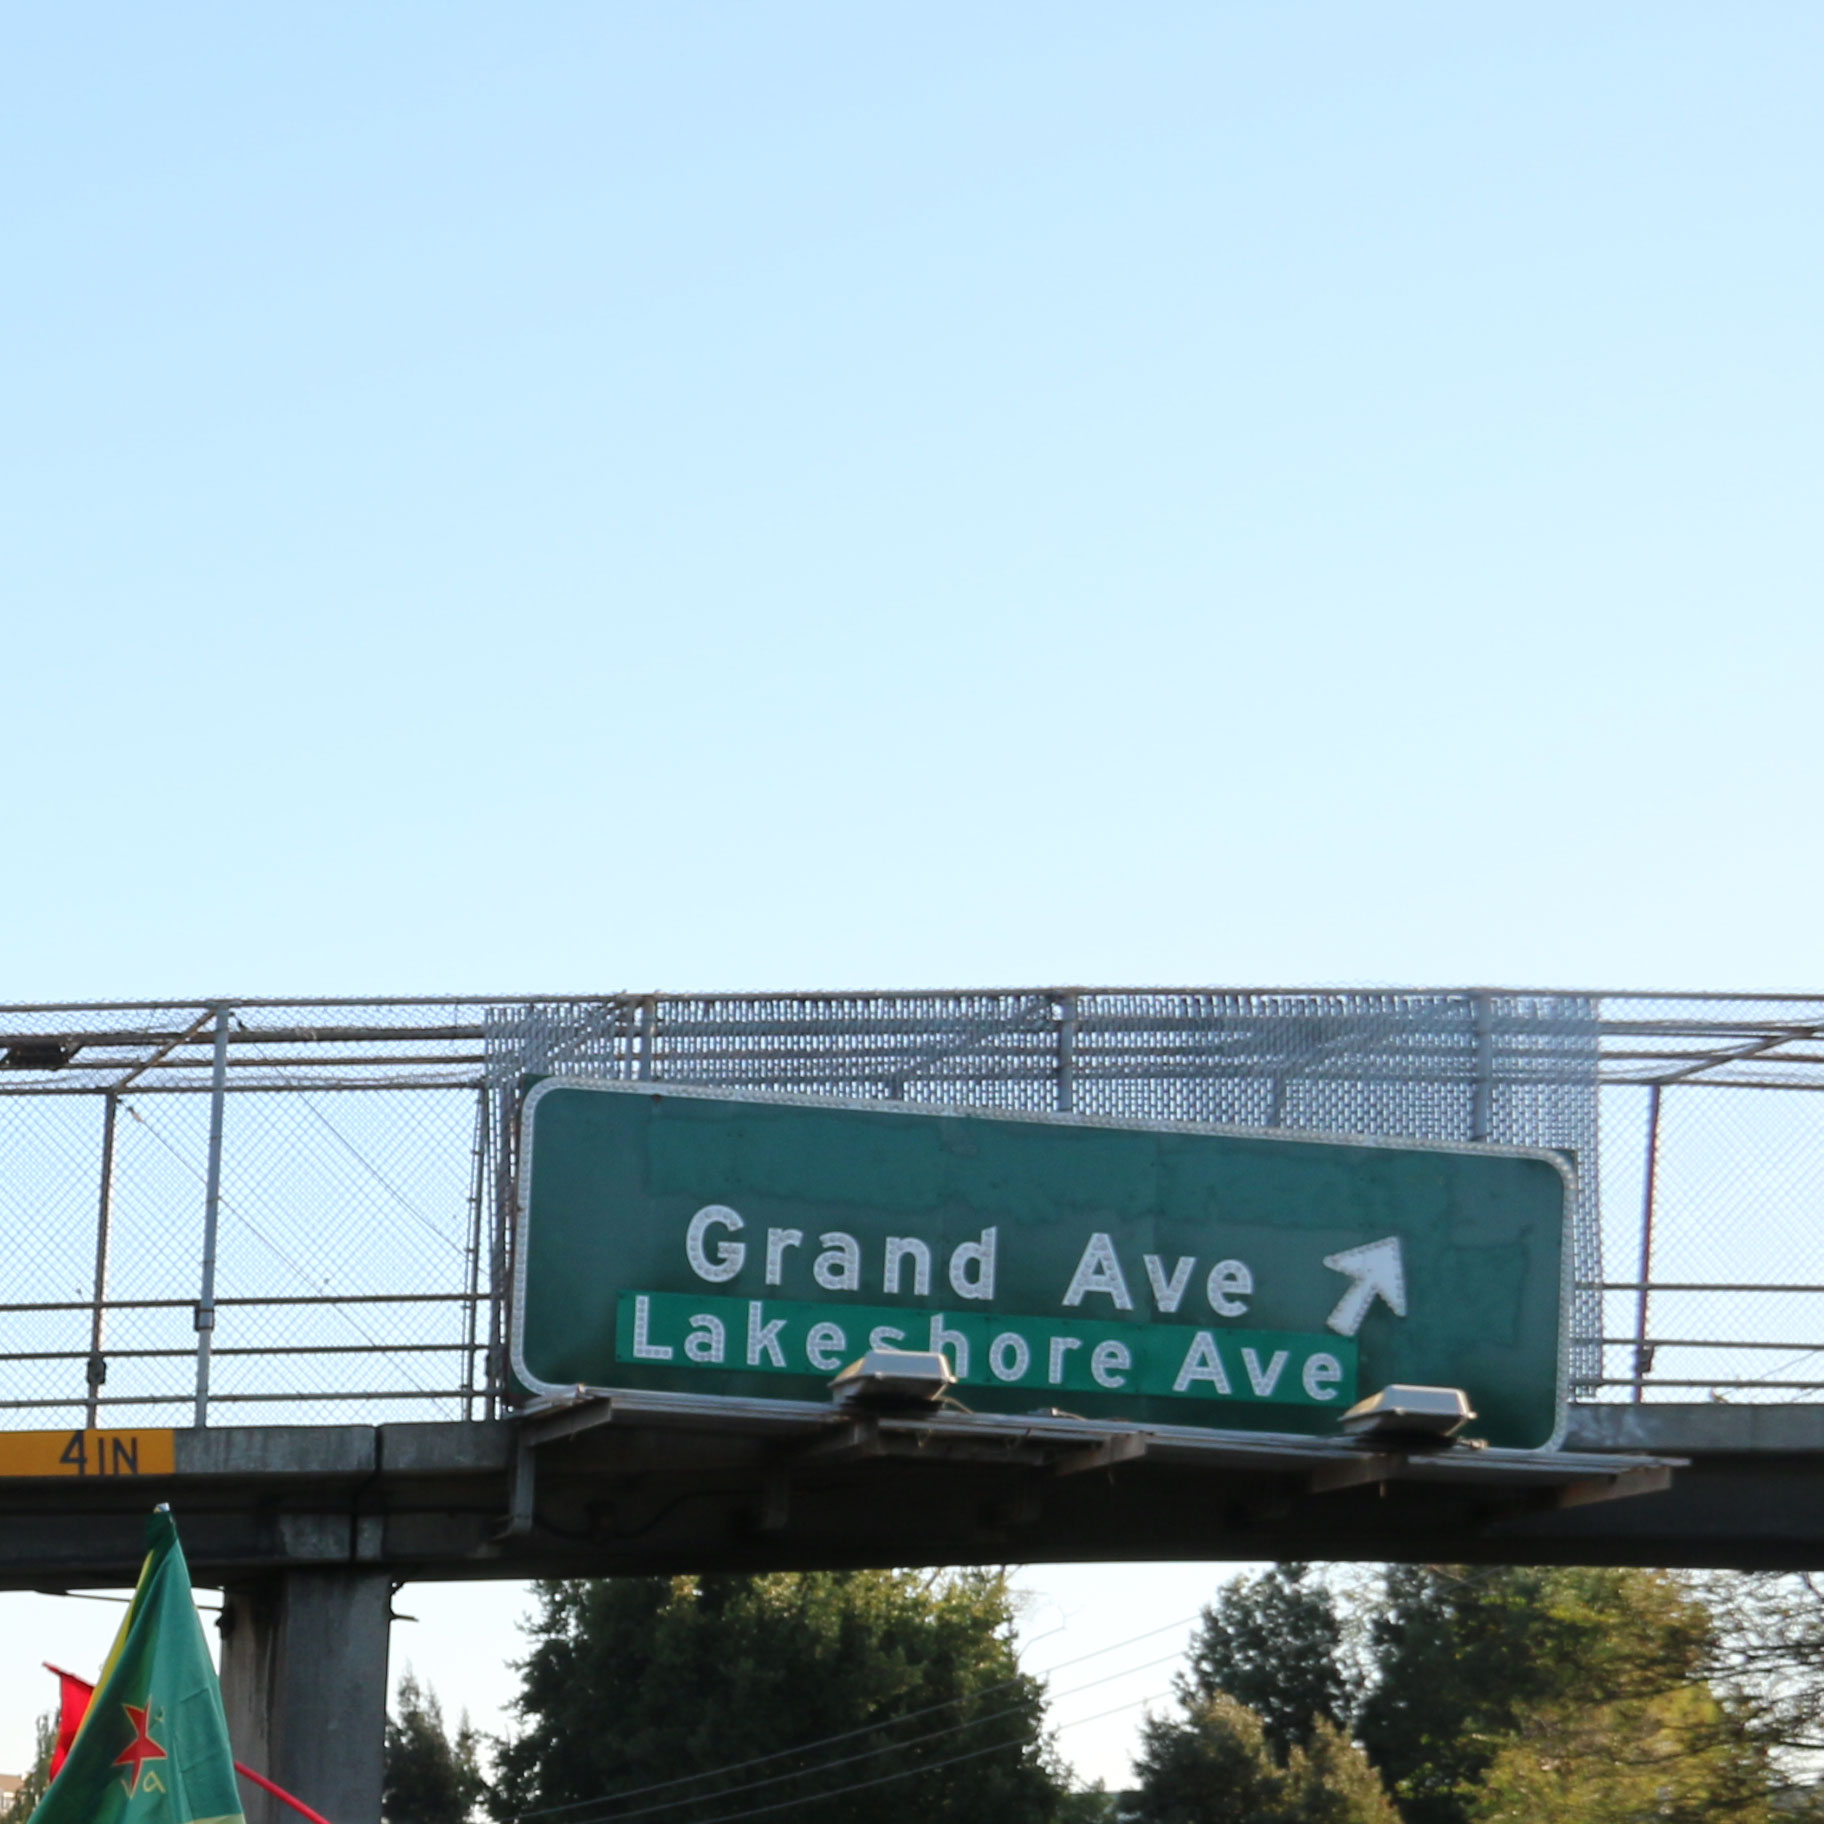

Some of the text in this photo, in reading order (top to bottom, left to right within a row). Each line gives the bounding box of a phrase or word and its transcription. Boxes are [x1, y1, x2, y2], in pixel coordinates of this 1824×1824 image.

[685, 1203, 1254, 1318] Grand Ave
[632, 1294, 1344, 1401] Lakeshore Ave
